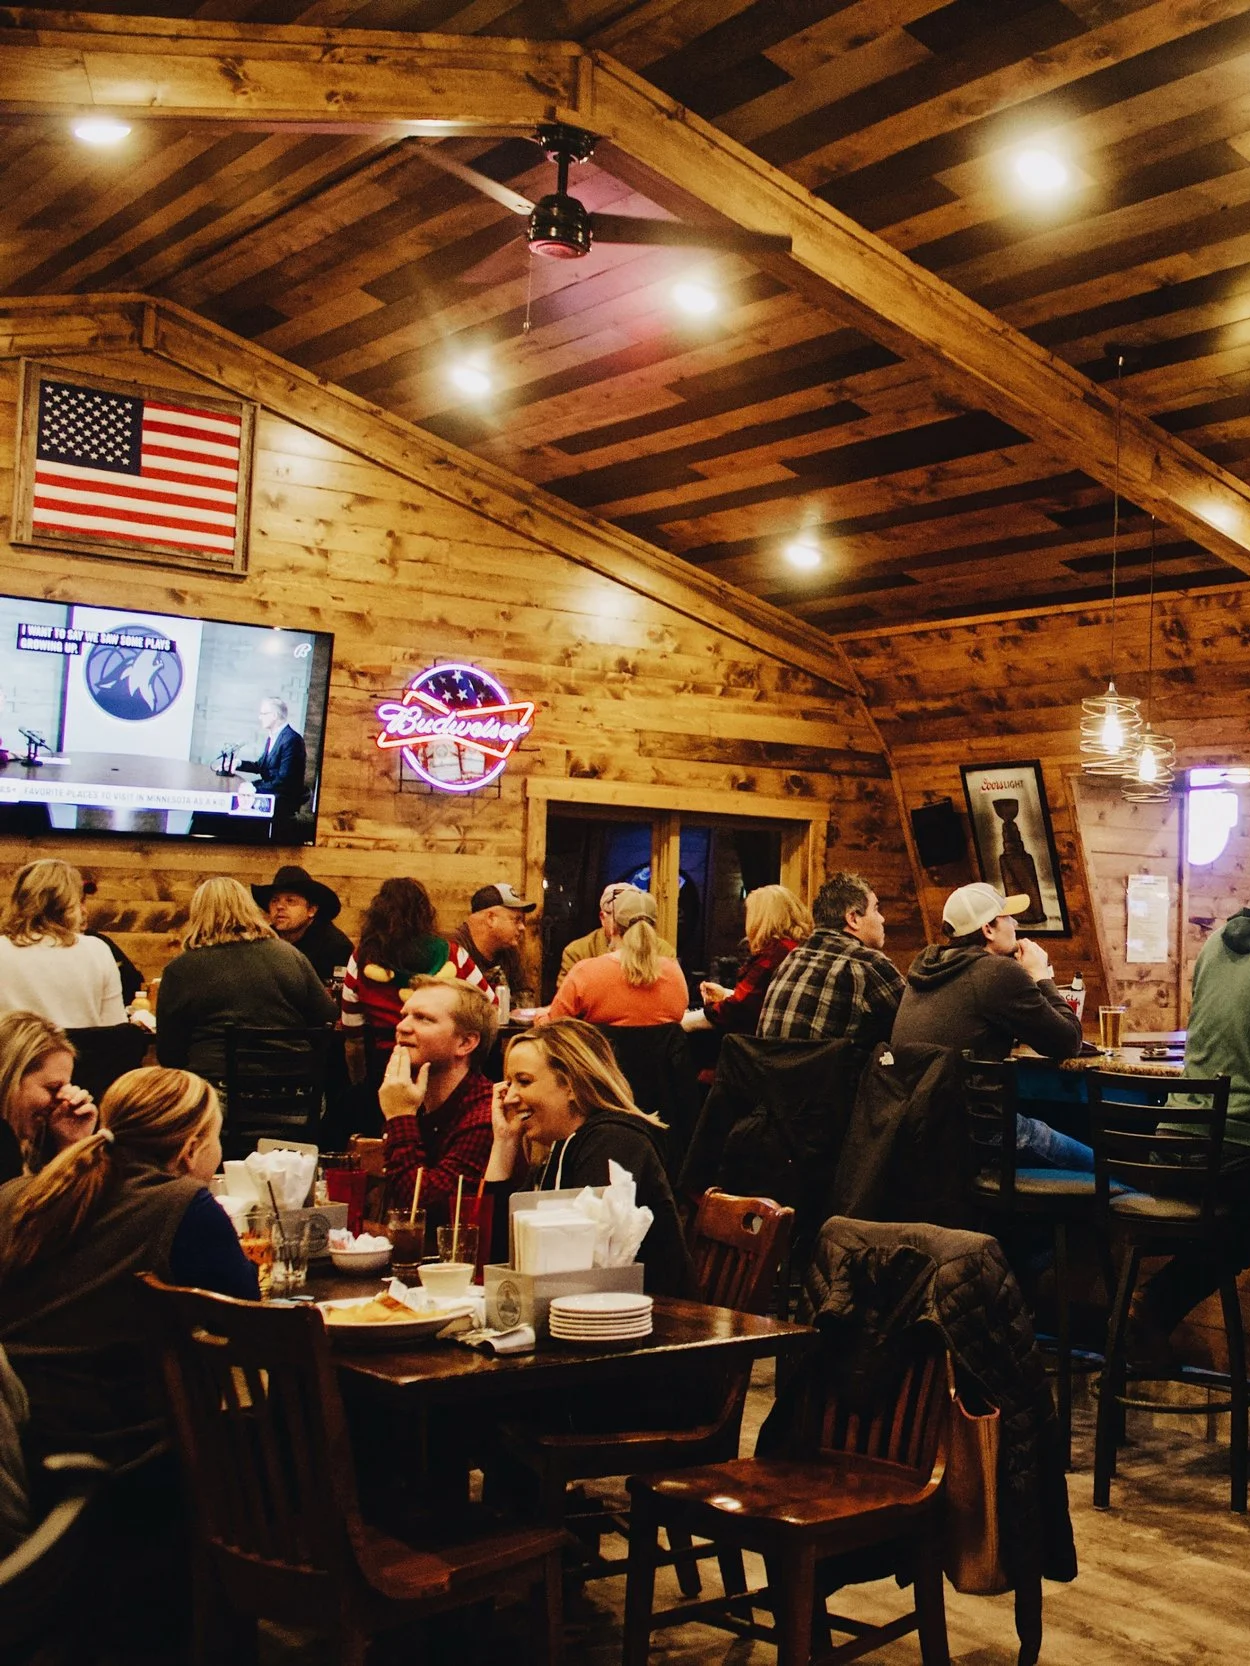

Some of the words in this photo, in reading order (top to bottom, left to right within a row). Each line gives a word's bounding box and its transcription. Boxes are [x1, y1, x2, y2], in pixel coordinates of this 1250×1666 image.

[20, 638, 63, 653] GROWING
[27, 625, 52, 638] WANT
[54, 627, 66, 639] TO
[67, 629, 83, 641] SAY
[83, 631, 100, 643] WE
[100, 633, 119, 646] SAW
[120, 635, 144, 648] SOME
[145, 638, 171, 651] PLAYS
[377, 704, 530, 741] Budweiser
[981, 777, 1004, 791] Coors
[1004, 780, 1024, 789] LIGHT
[24, 787, 63, 797] FAVORITE
[147, 794, 191, 804] MINNESOTA
